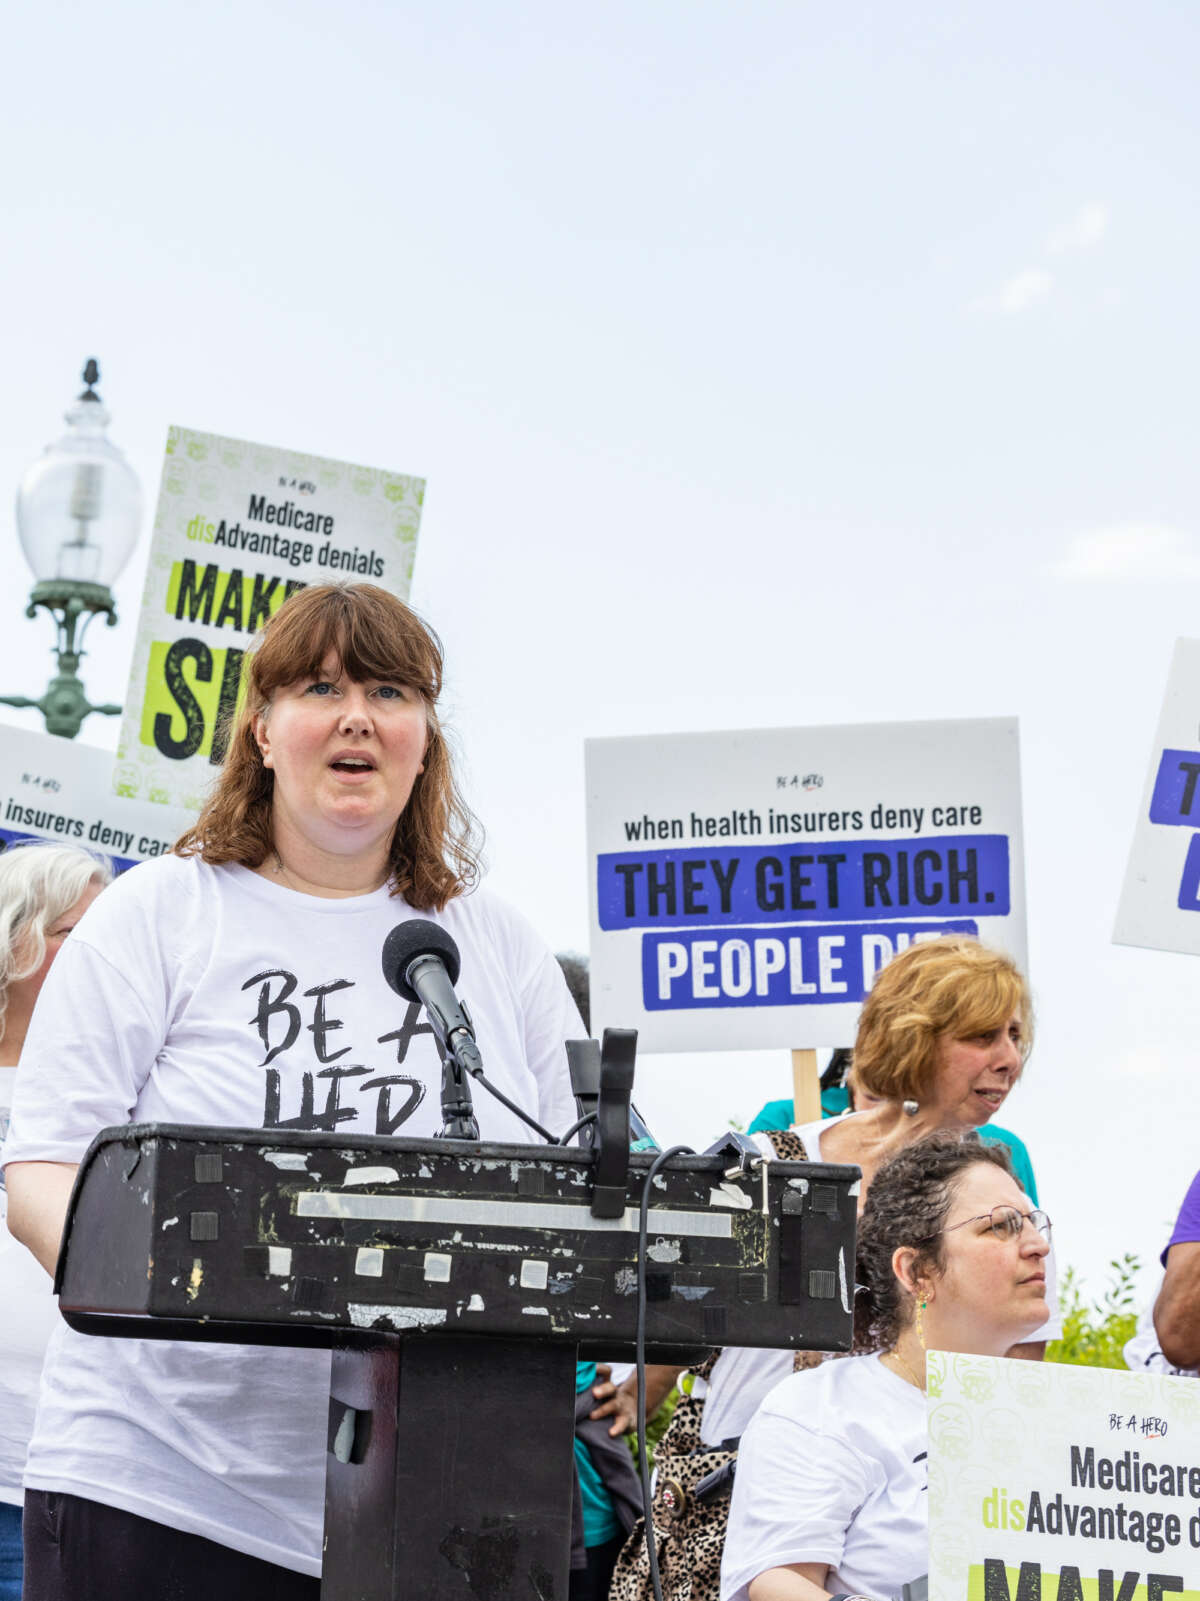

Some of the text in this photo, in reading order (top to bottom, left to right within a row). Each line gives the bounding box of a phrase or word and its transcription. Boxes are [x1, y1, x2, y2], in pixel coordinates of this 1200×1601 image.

[248, 494, 334, 536] Medicare
[186, 514, 385, 578] disAdvantage denials
[5, 797, 84, 837] insurers
[89, 819, 134, 855] deny
[138, 836, 169, 856] car
[624, 803, 982, 841] when health insurers deny care
[614, 848, 995, 918] THEY GET RICH.
[657, 934, 848, 1000] PEOPLE
[241, 968, 356, 1066] BE
[1109, 1414, 1168, 1437] BE A HERO
[1070, 1445, 1200, 1499] Medicare
[981, 1487, 1181, 1554] disAdvantage
